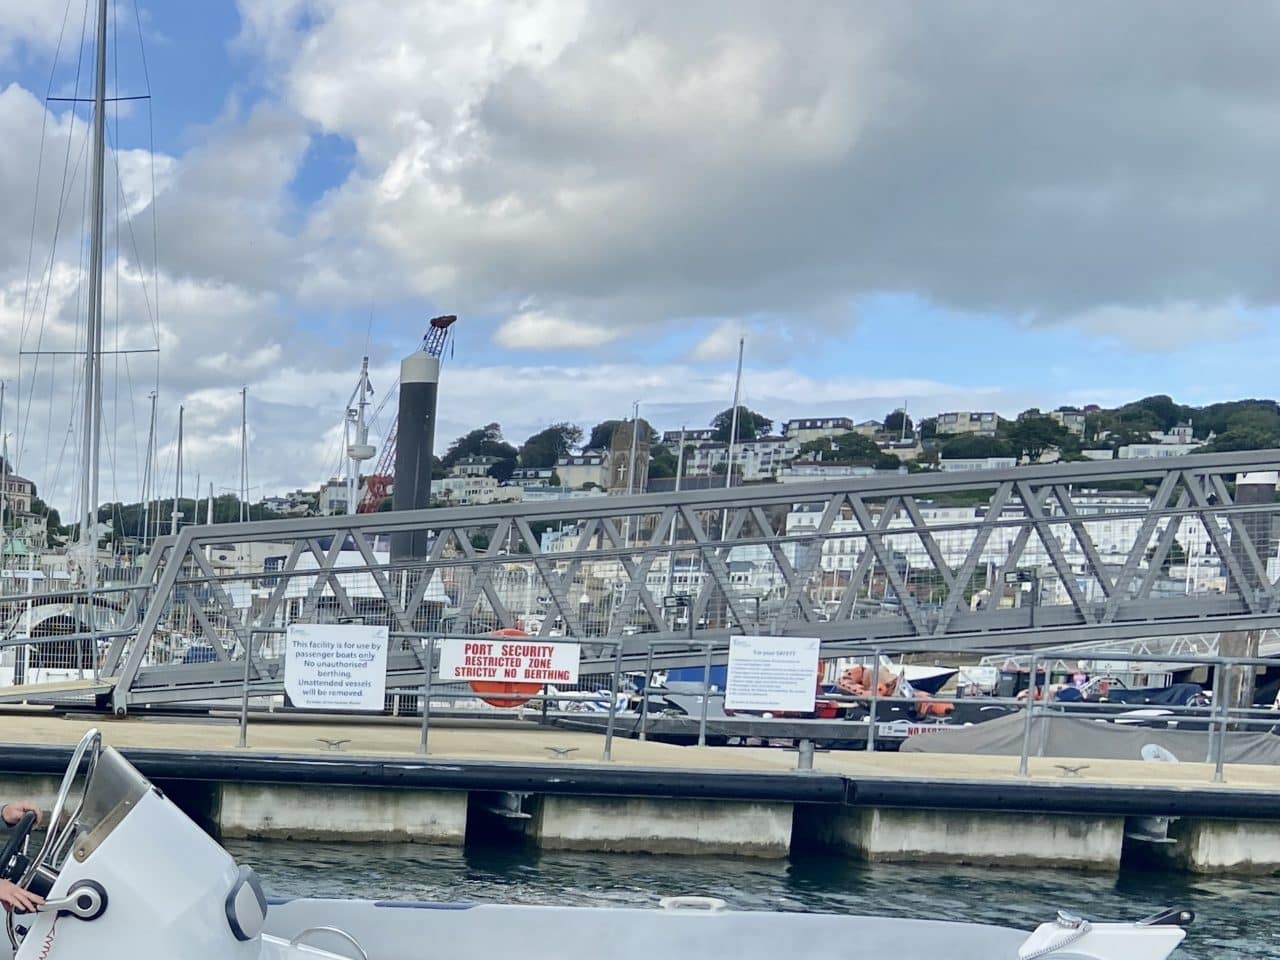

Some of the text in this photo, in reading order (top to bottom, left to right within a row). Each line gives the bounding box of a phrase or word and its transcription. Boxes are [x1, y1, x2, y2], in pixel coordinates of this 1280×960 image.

[292, 640, 307, 648] This
[309, 641, 335, 650] facility
[371, 642, 381, 650] by
[465, 644, 554, 658] PORT SECURITY
[359, 652, 375, 661] only
[465, 656, 552, 669] RESTRICTED ZONE
[455, 667, 569, 680] STRICTLY NO BERTHING
